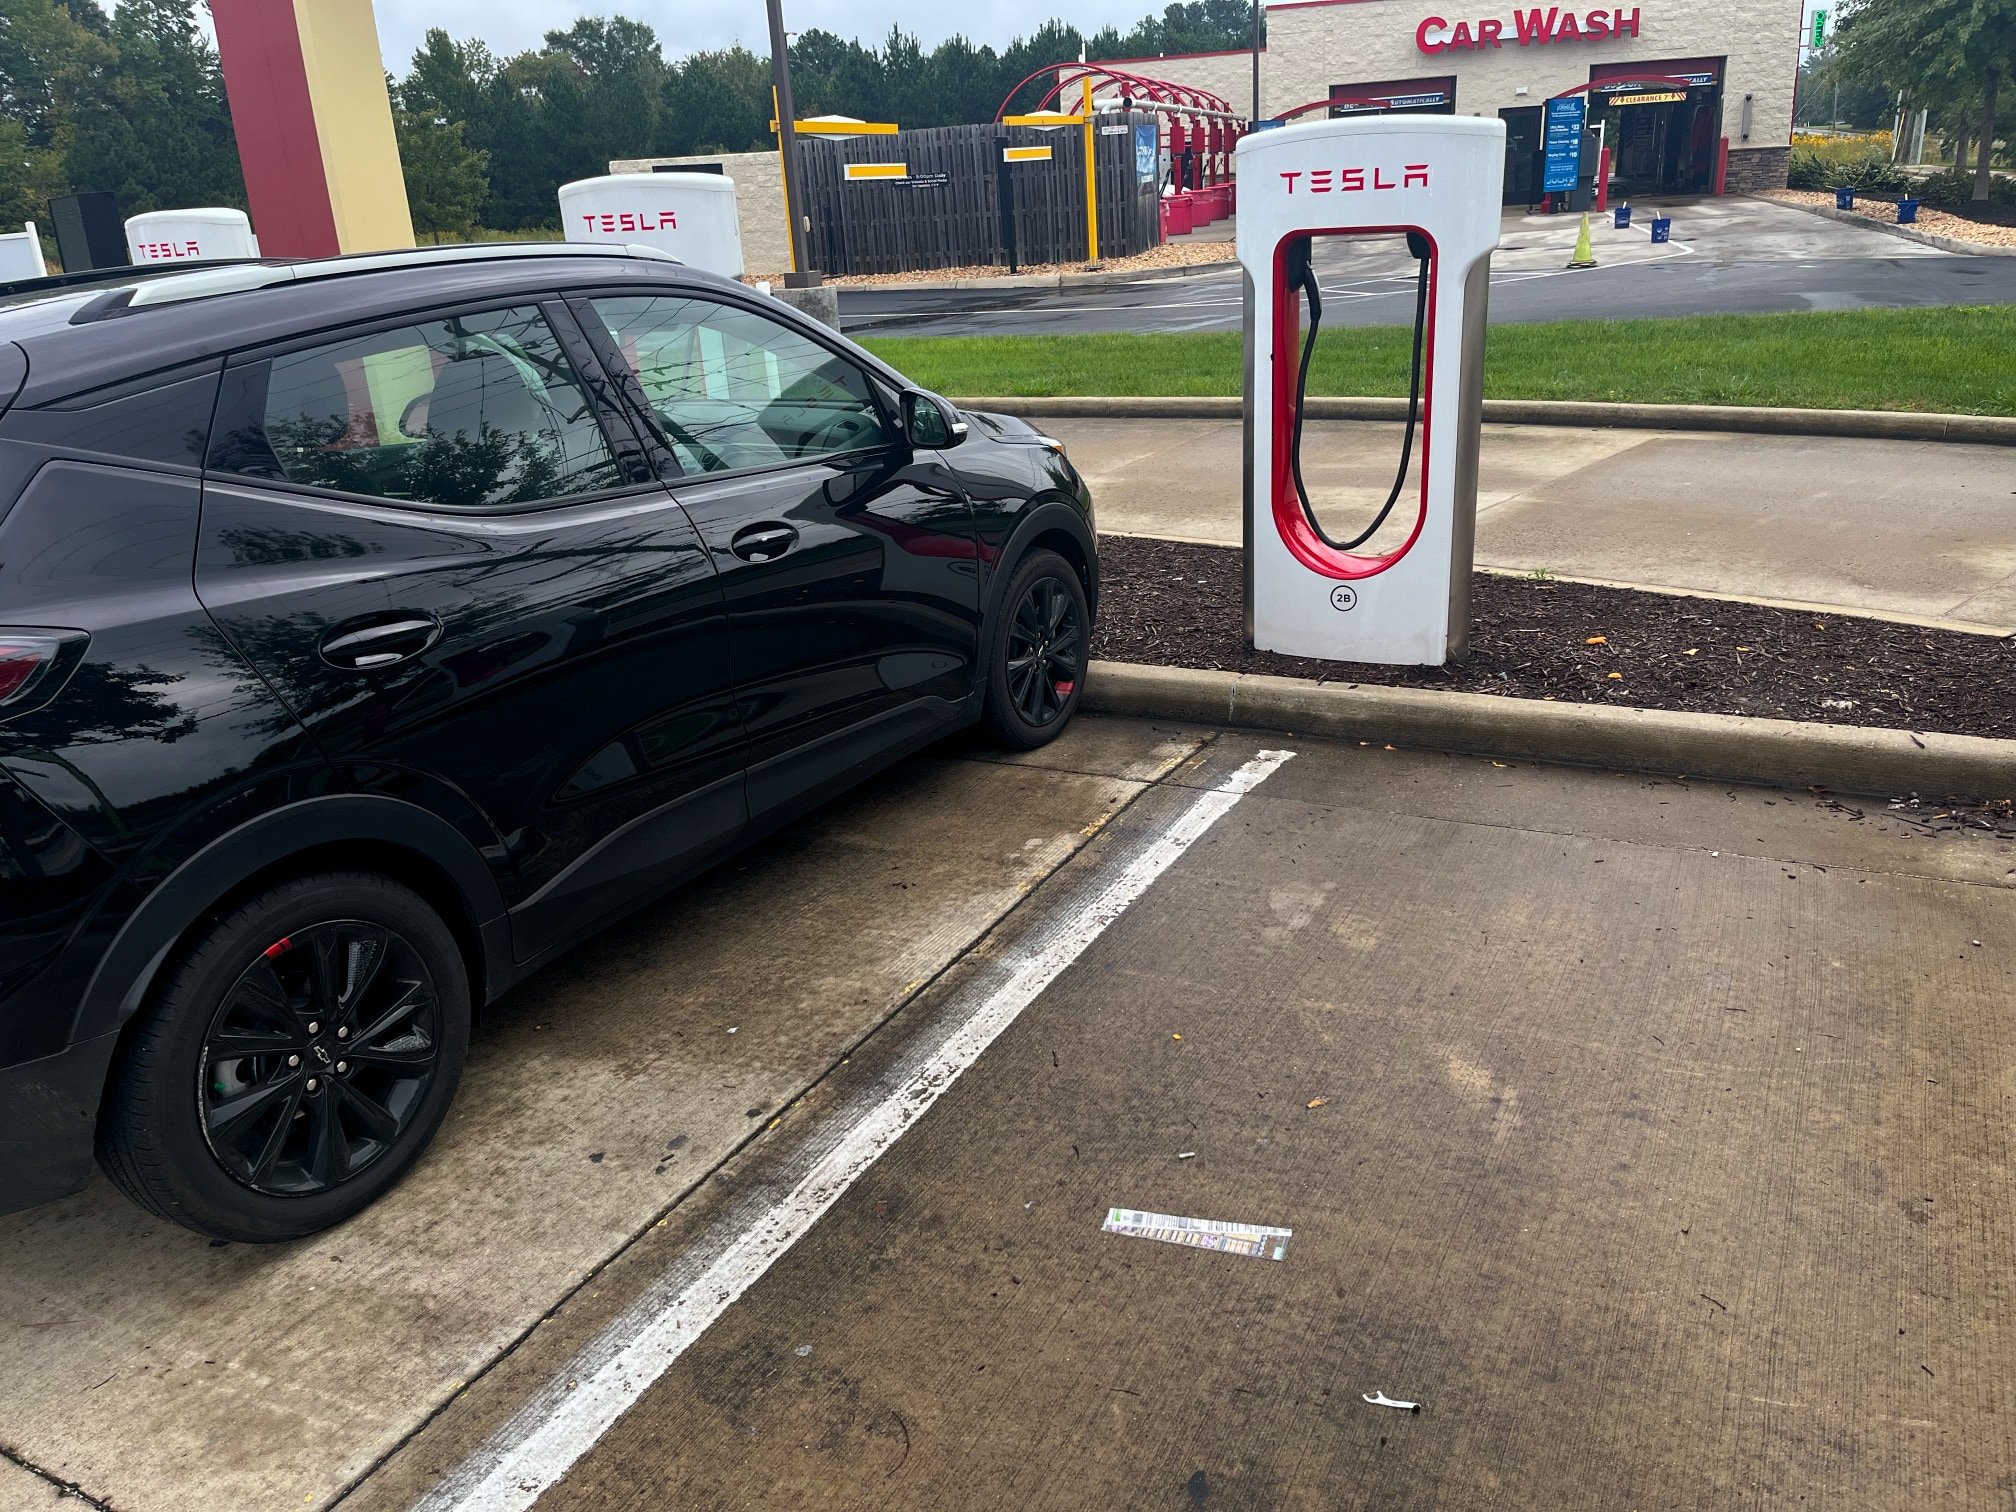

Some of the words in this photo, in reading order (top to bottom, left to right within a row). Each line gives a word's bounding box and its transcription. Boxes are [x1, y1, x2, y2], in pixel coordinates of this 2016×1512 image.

[1416, 16, 1503, 55] CAR
[1513, 7, 1641, 47] WASH
[1814, 11, 1825, 48] OPEN
[1625, 94, 1662, 103] CLEARANCE
[1279, 164, 1429, 195] TESLA
[582, 211, 677, 233] TESLA
[138, 241, 200, 259] TESLA
[1336, 593, 1351, 603] 2B
